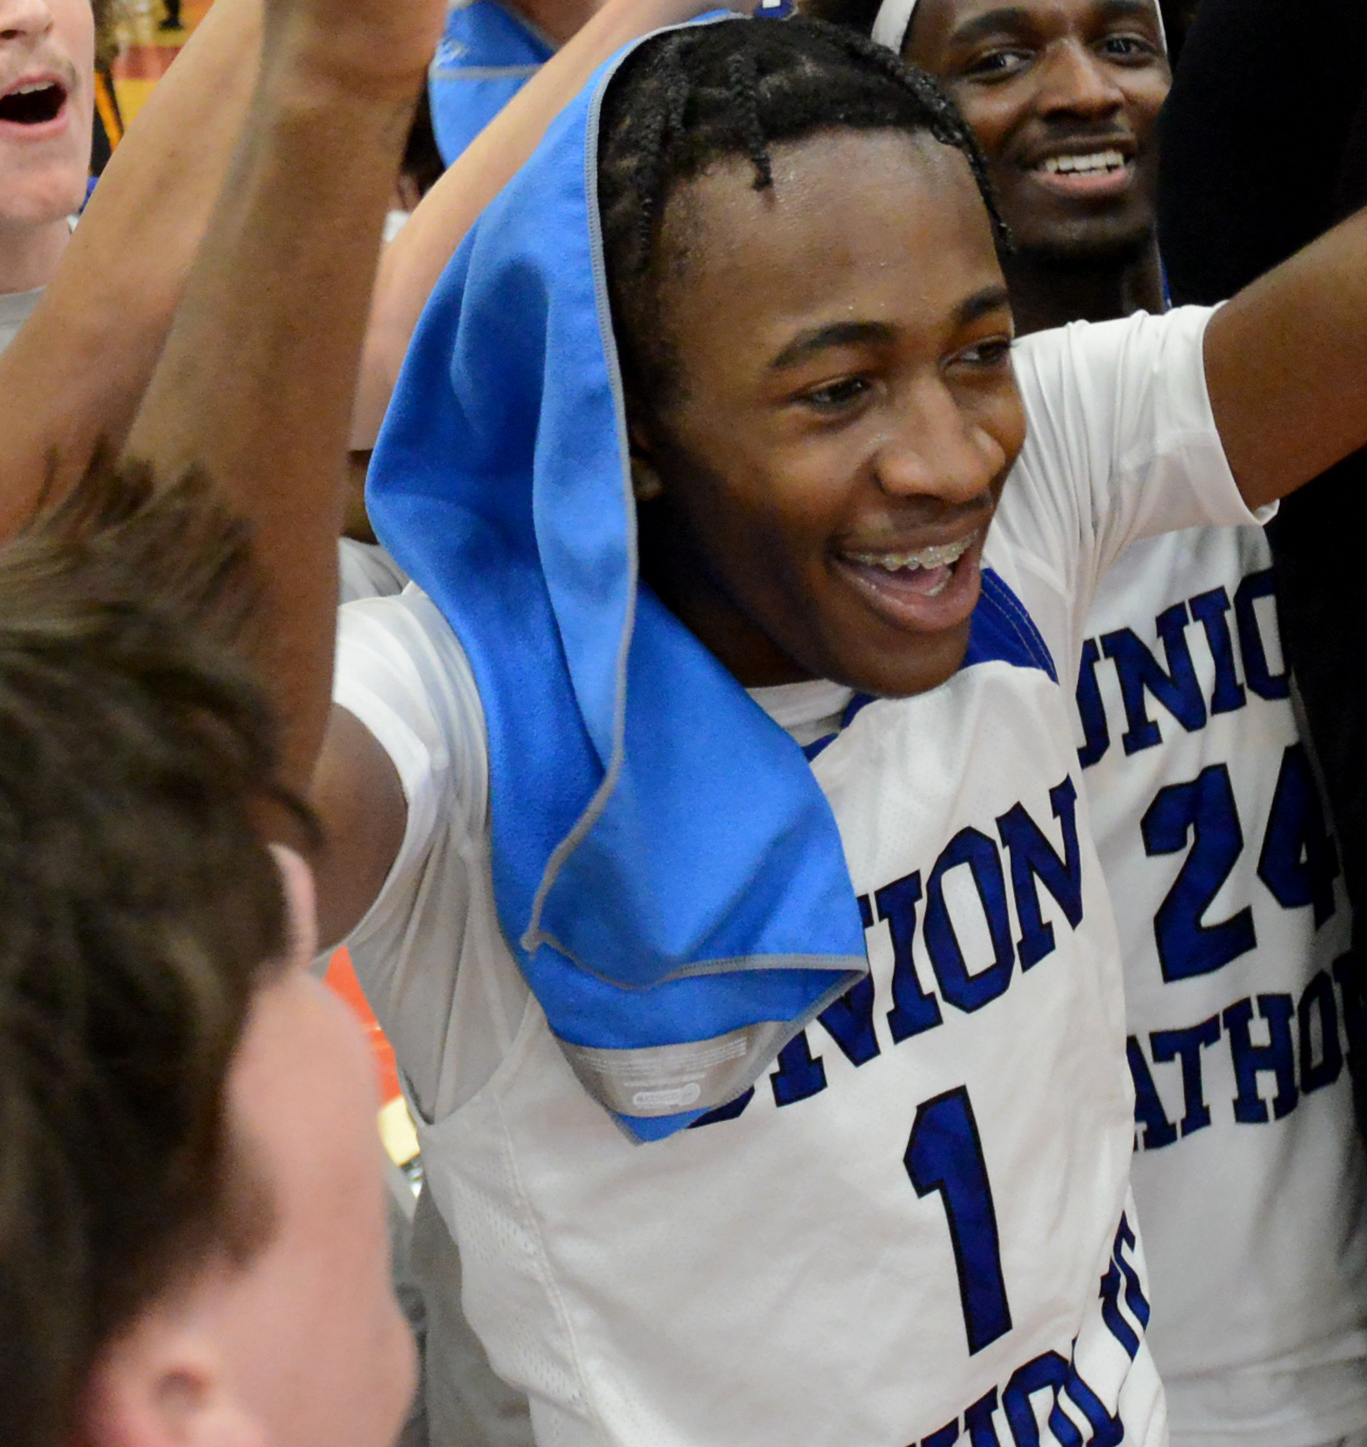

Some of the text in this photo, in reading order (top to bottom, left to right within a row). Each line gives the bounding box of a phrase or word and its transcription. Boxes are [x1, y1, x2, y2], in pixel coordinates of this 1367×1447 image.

[688, 774, 1084, 1130] NION
[1140, 740, 1344, 984] 24
[1126, 951, 1367, 1153] ATHO
[902, 1084, 1014, 1358] 1
